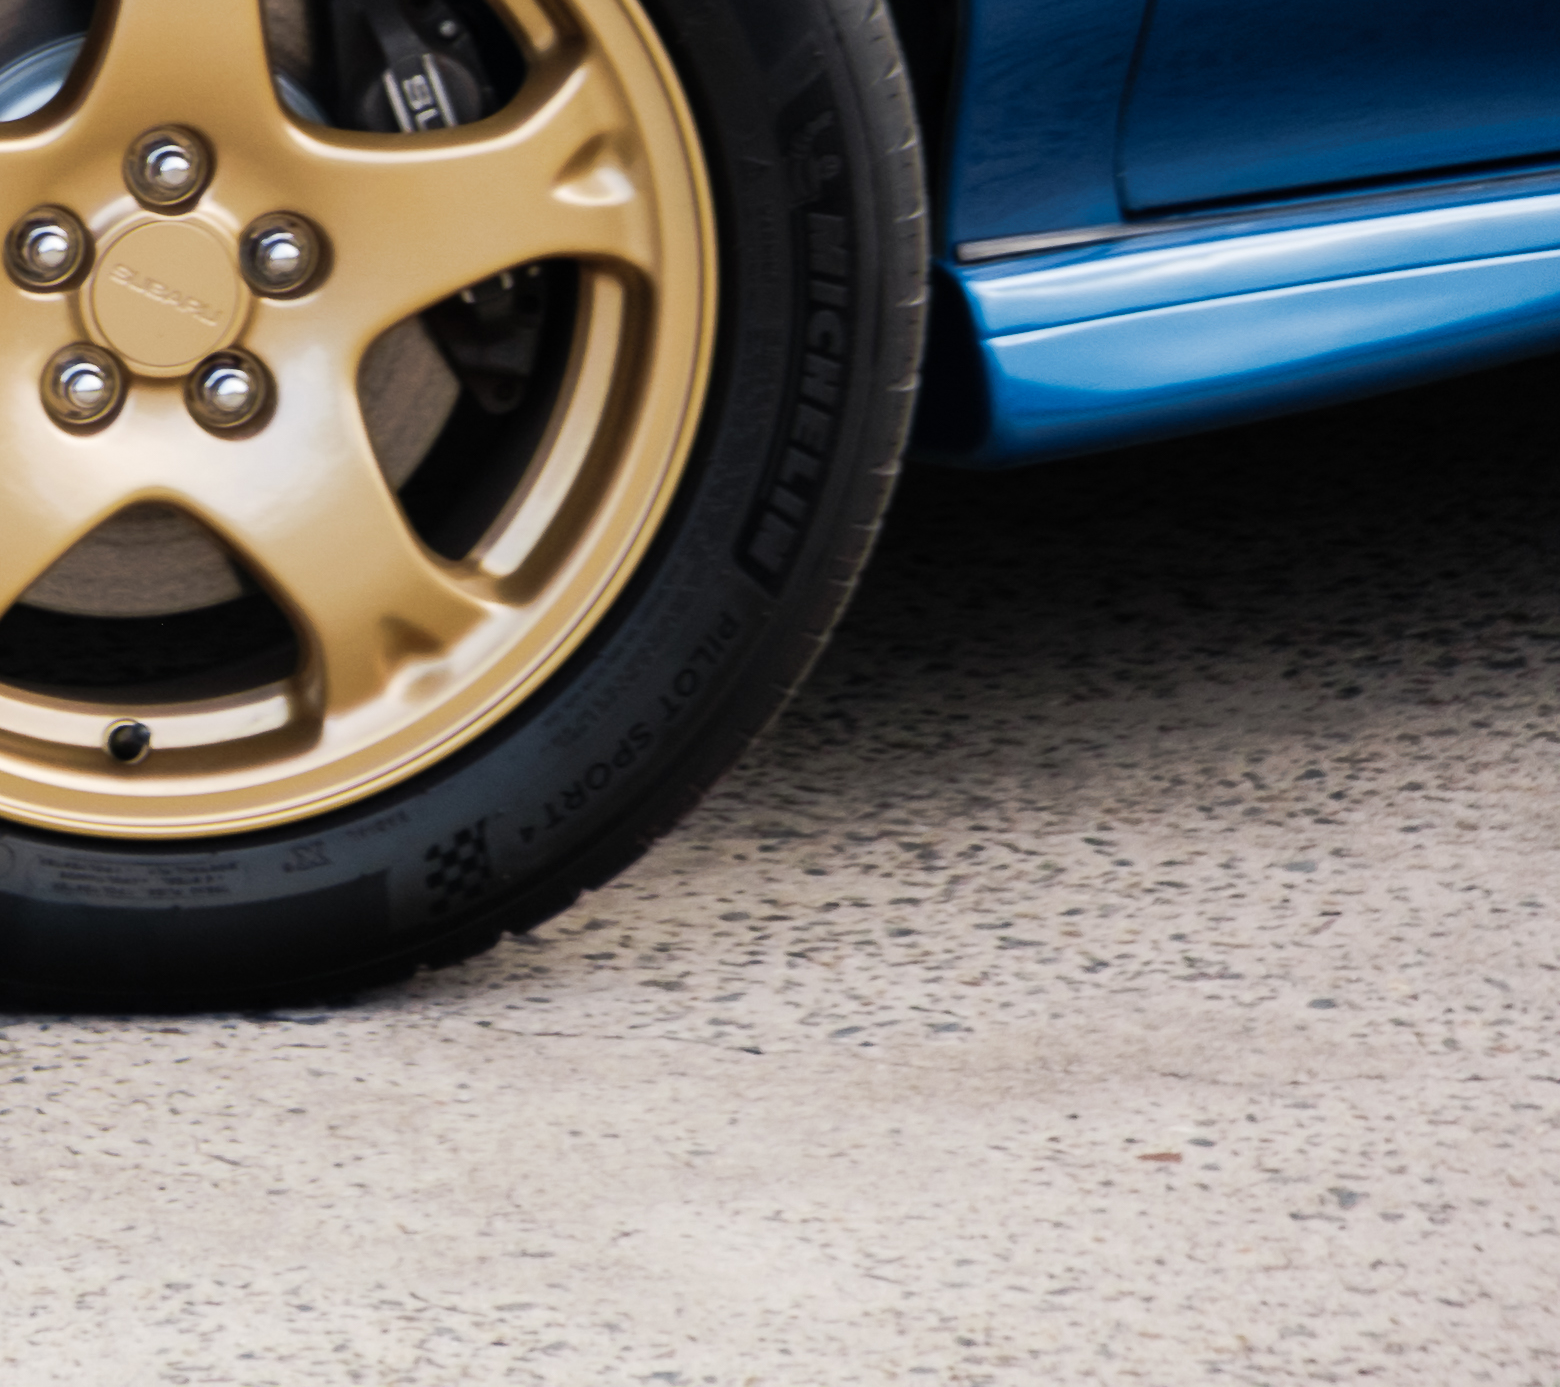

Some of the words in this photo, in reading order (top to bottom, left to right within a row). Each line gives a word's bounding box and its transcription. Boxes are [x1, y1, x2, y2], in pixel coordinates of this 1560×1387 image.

[108, 263, 223, 327] SUBARU
[747, 211, 850, 575] MICHELIN
[659, 611, 742, 722] PILOT
[544, 722, 653, 829] SPORT
